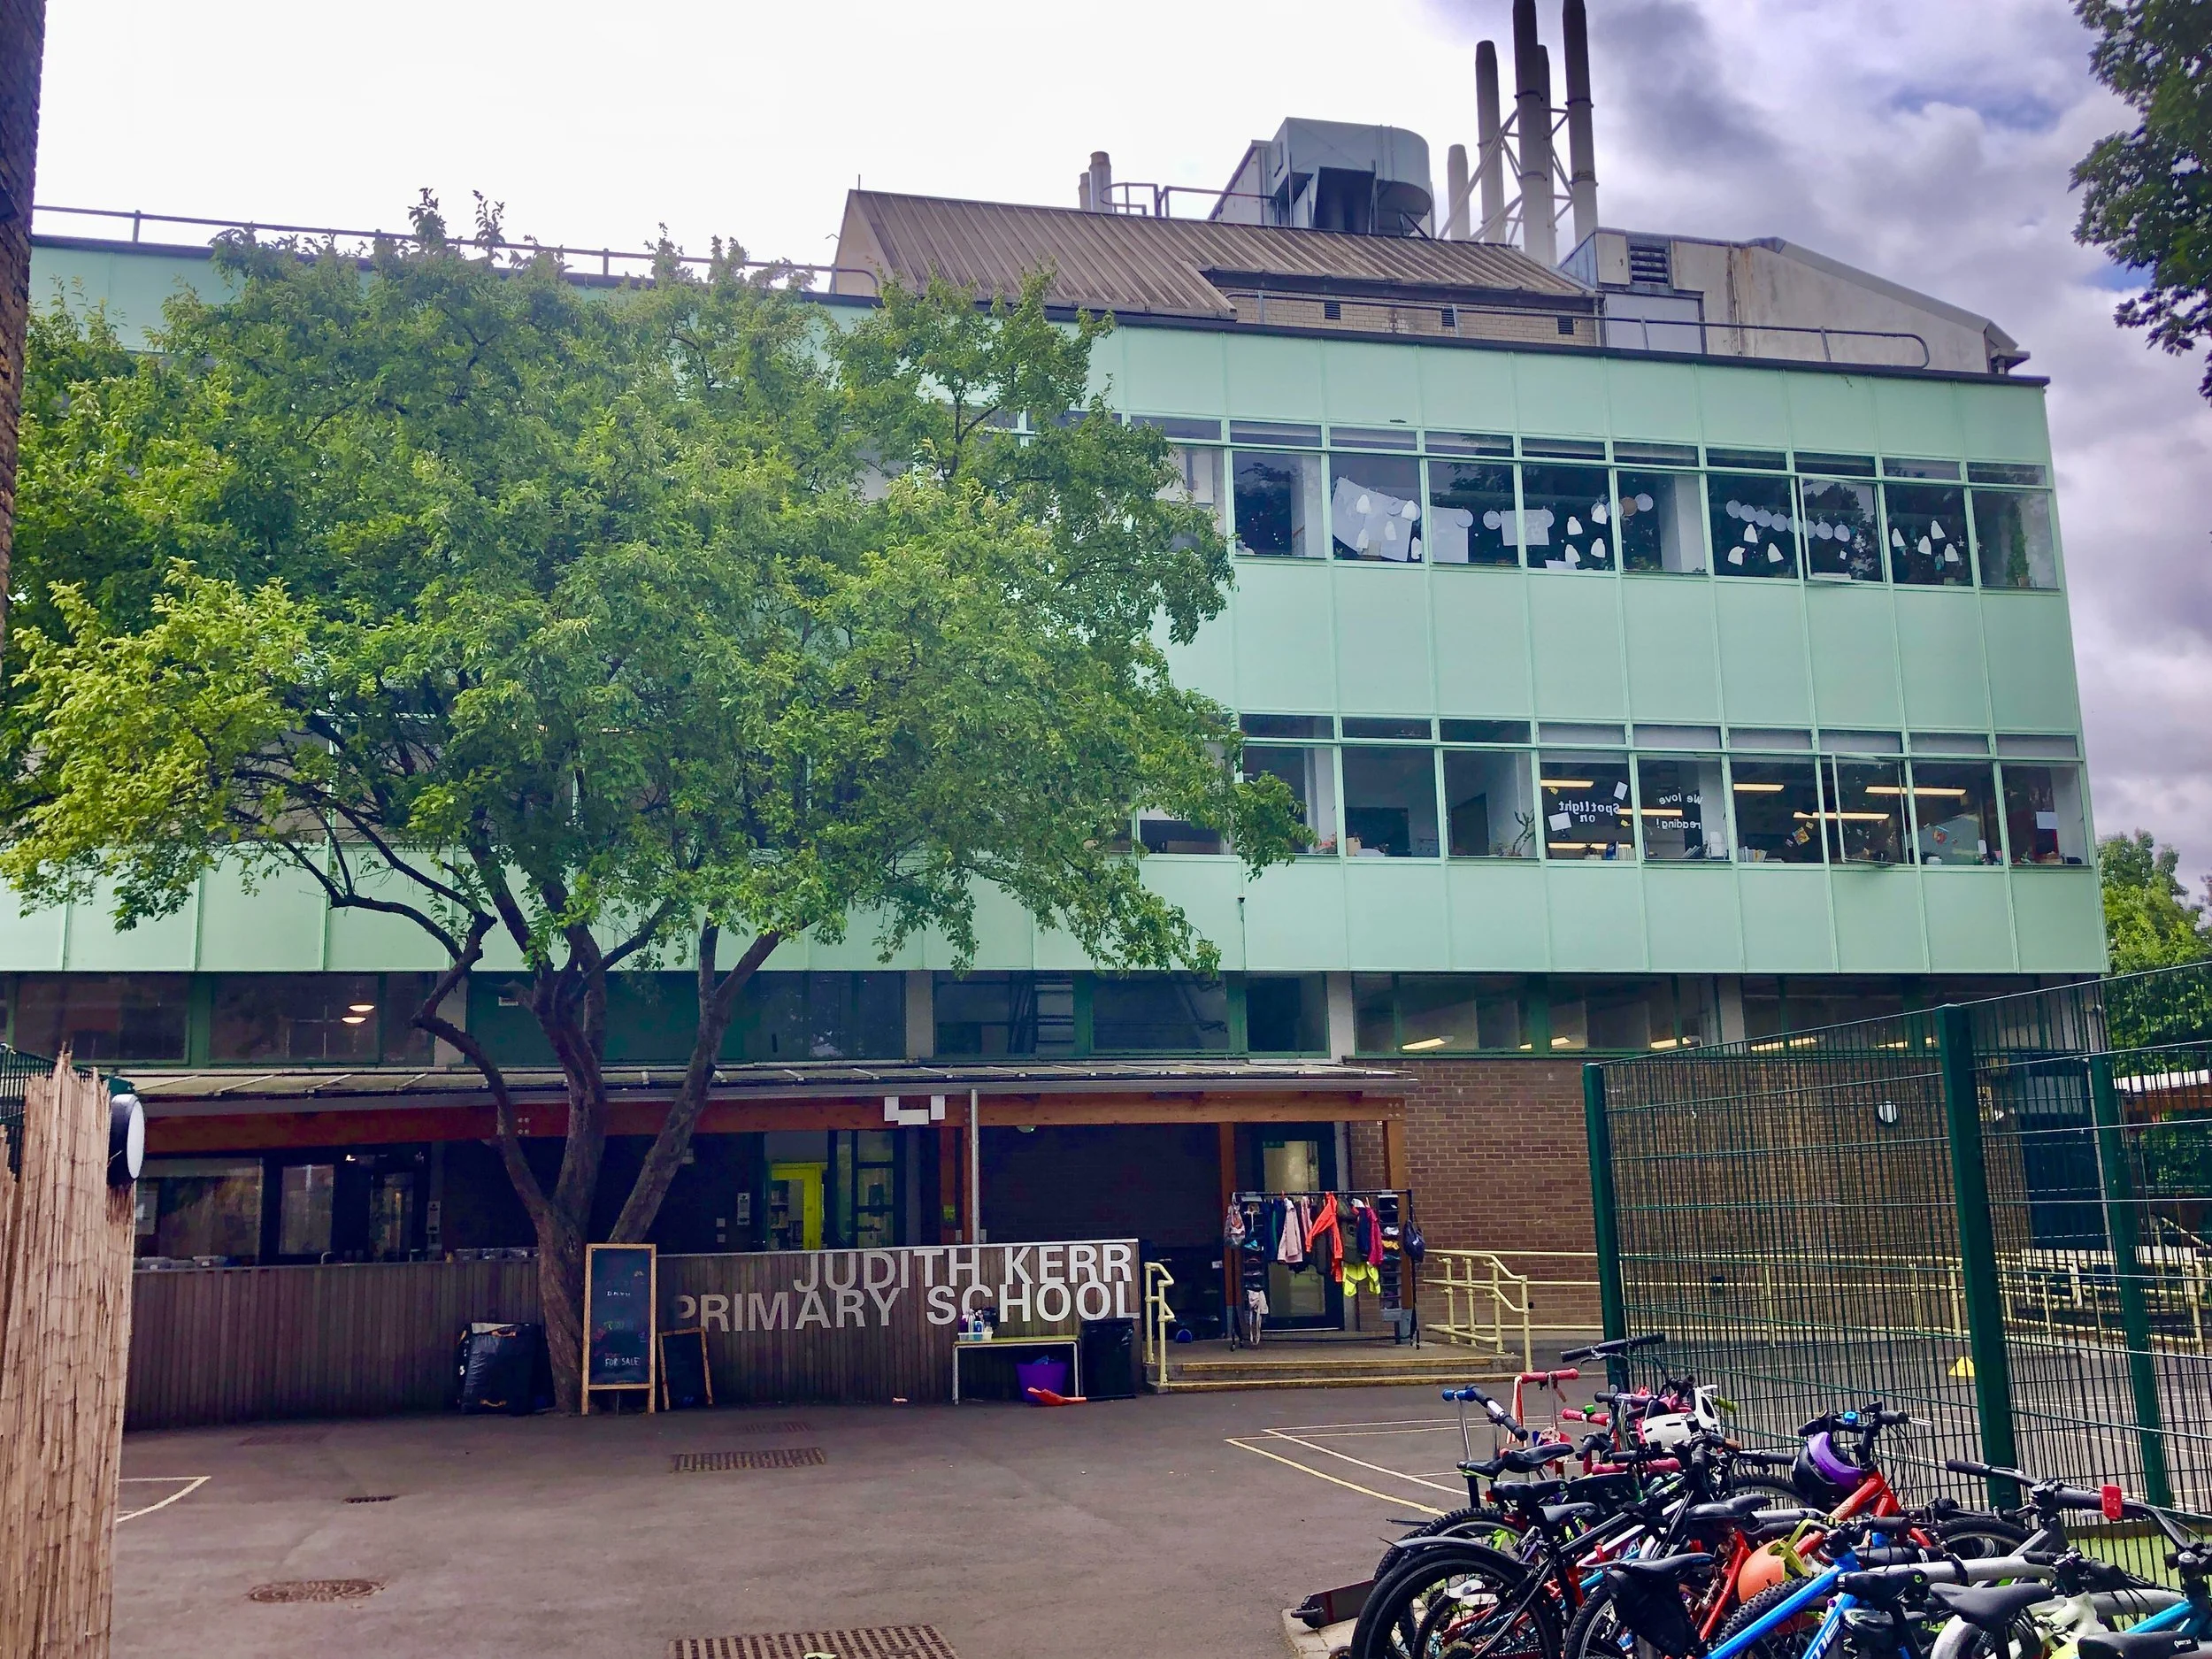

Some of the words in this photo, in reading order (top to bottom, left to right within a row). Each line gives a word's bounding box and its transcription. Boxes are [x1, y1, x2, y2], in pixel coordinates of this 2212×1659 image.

[793, 1248, 979, 1292] JUDITH
[1004, 1244, 1133, 1285] KERR
[926, 1280, 1140, 1325] SCHOOL
[604, 1357, 618, 1366] FOR
[621, 1356, 641, 1366] SALE
